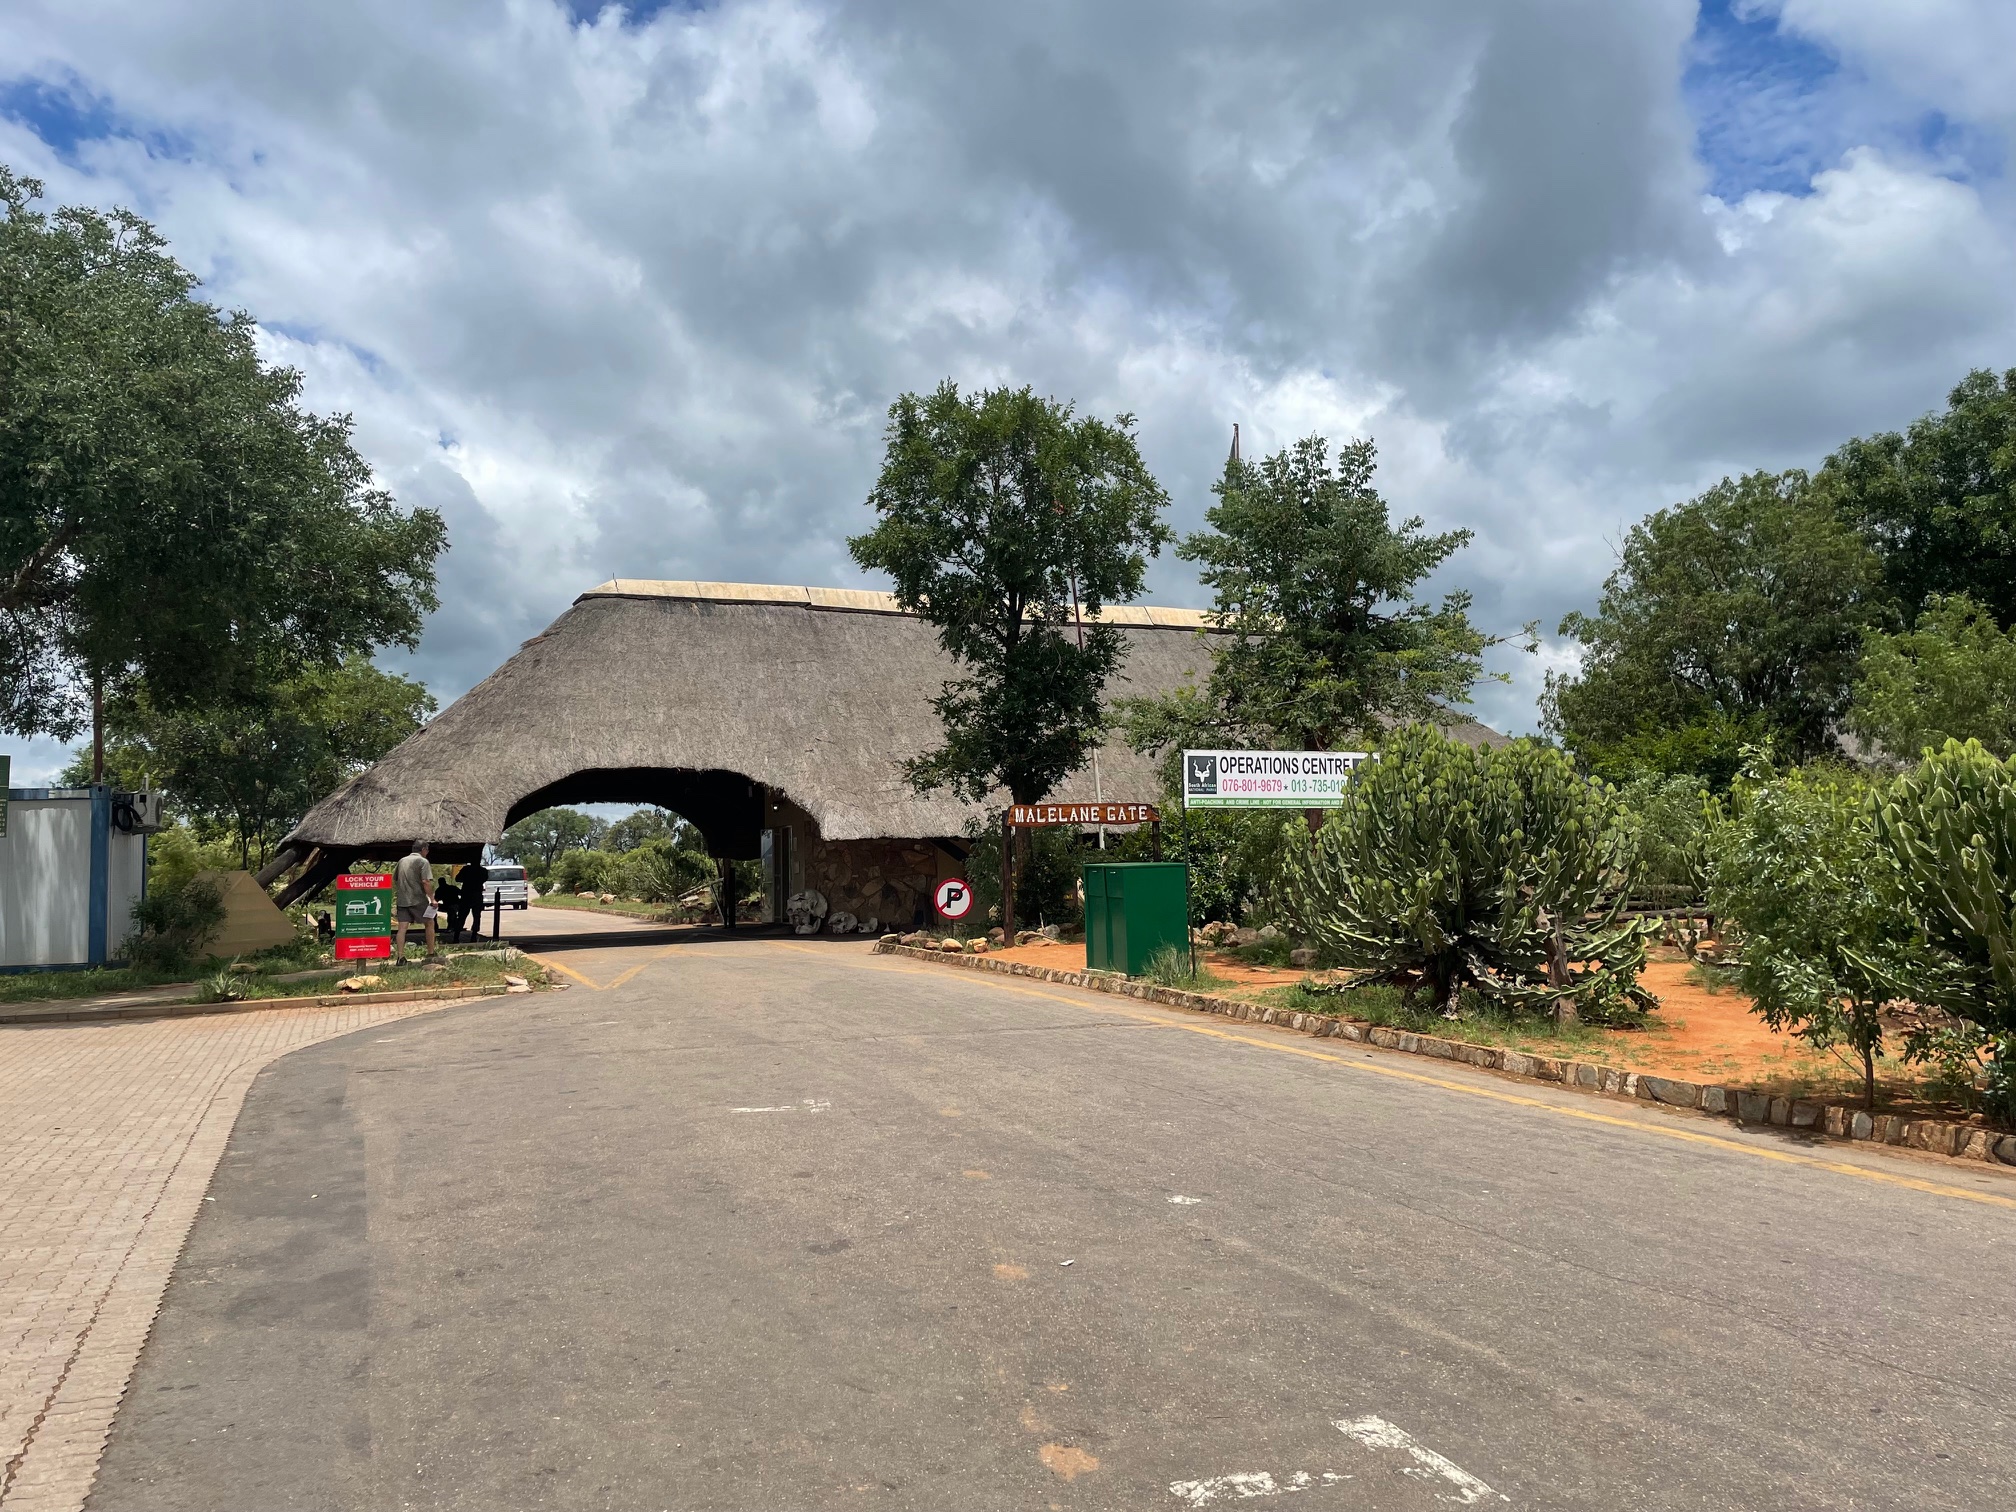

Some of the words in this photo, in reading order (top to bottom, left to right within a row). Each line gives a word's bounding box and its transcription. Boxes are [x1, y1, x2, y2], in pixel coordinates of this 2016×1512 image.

[1220, 757, 1298, 774] OPERATIONS
[1302, 757, 1350, 774] CENTRE
[1222, 779, 1282, 792] 076-801-9679
[1291, 779, 1308, 792] 013
[1015, 807, 1100, 823] MALELANE
[1107, 806, 1148, 821] GATE
